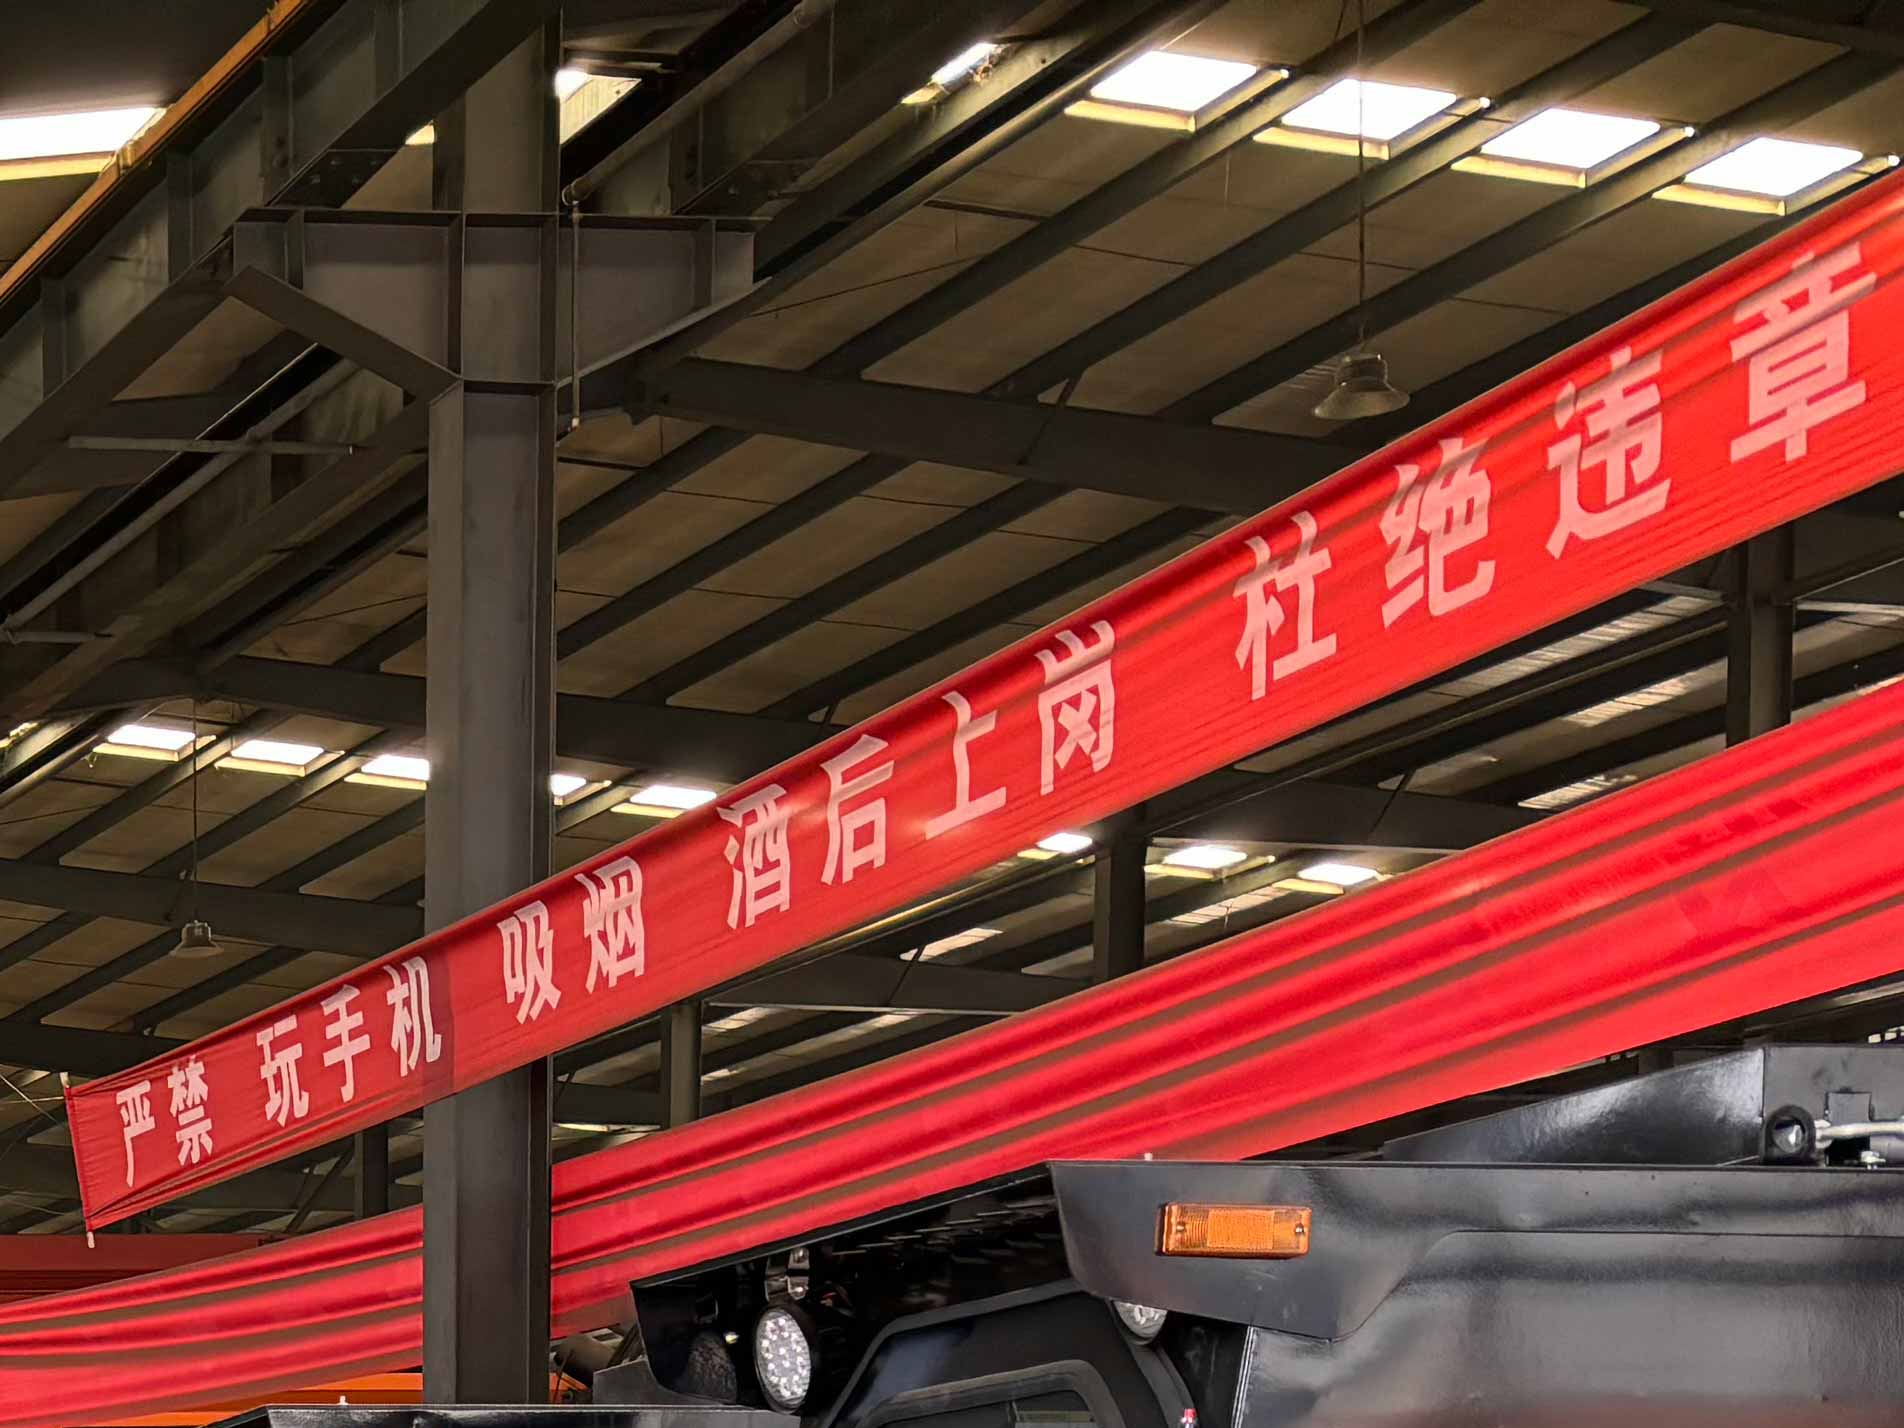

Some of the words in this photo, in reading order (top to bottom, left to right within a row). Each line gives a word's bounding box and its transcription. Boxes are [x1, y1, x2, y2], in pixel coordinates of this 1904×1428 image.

[115, 1054, 213, 1187] 严禁
[256, 956, 443, 1128] 玩手机
[496, 856, 645, 1025] 吸烟
[715, 619, 1116, 930] 酒后上岗
[1234, 241, 1877, 701] 杜绝违章
